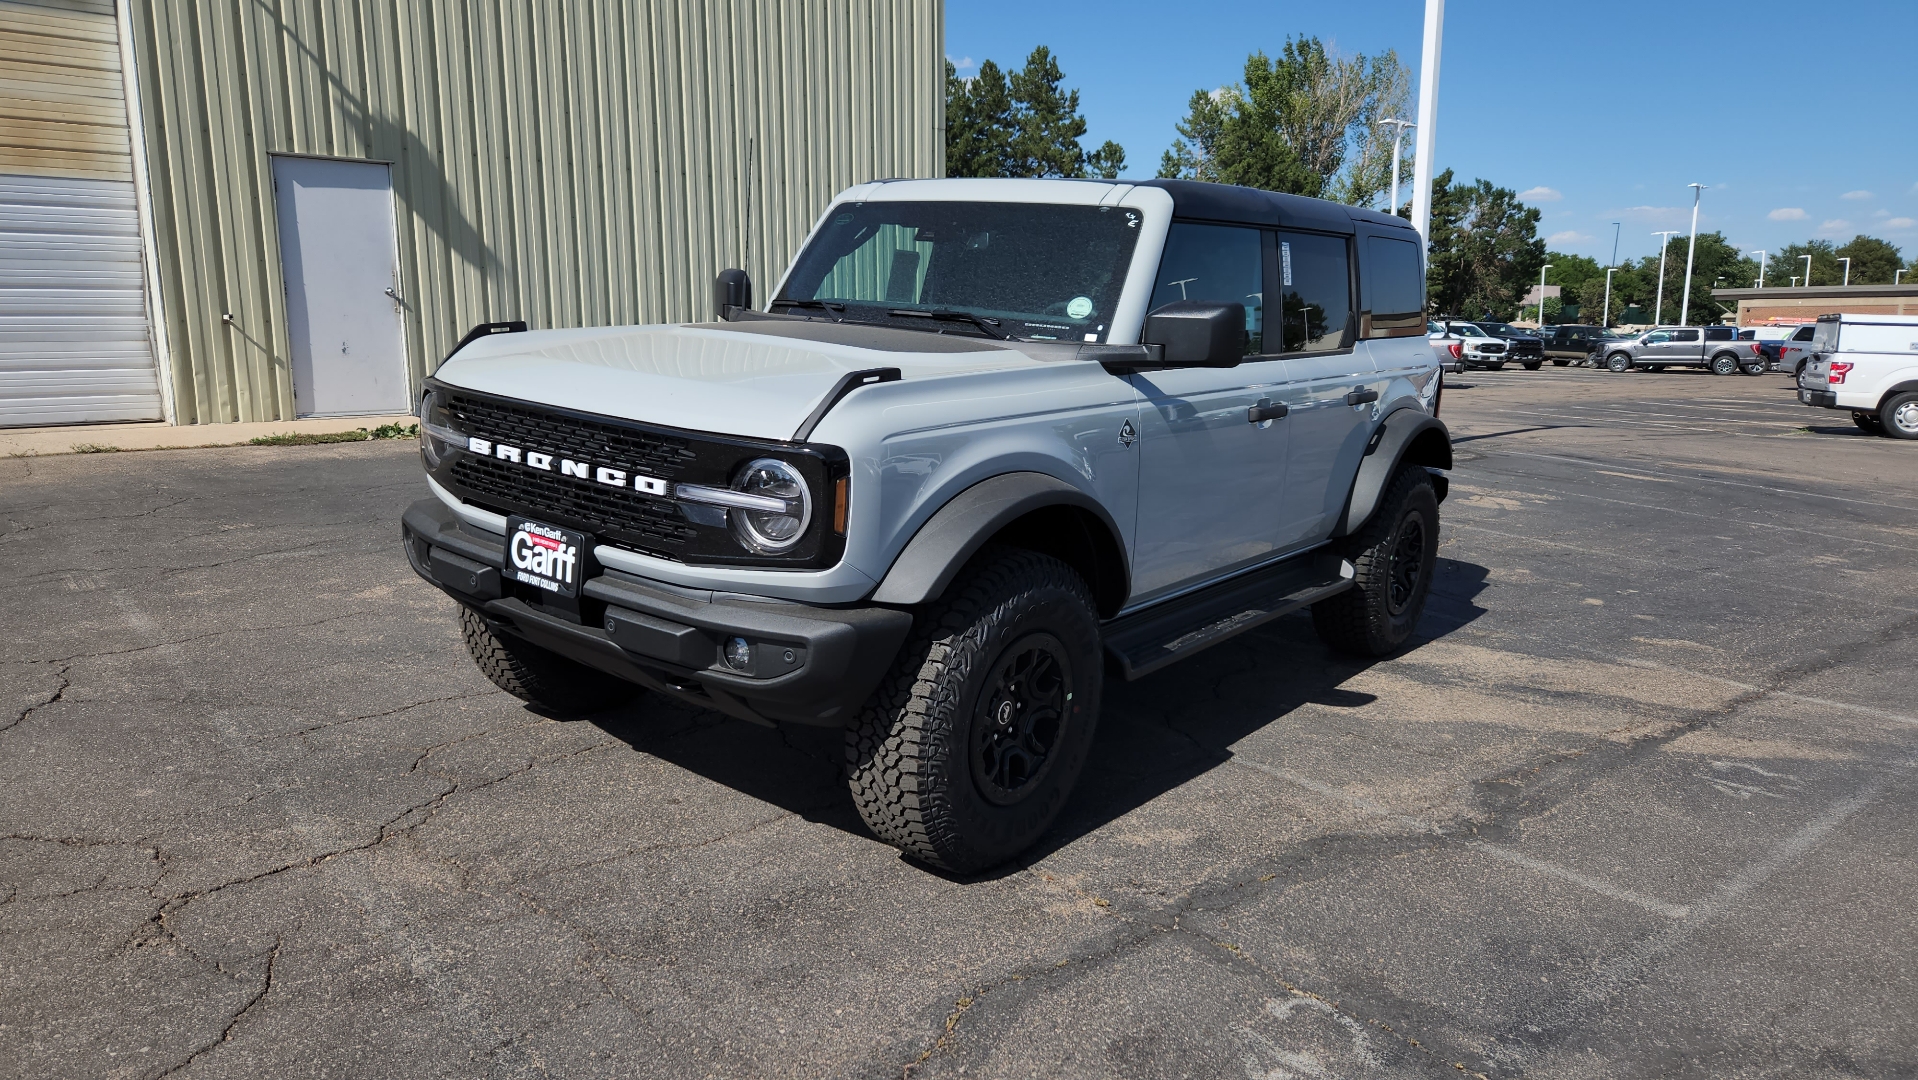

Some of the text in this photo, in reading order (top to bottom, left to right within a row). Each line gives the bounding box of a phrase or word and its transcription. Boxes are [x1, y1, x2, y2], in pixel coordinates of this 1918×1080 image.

[469, 437, 667, 496] BRONCO
[511, 530, 576, 584] Garff
[517, 571, 530, 583] FORD
[528, 575, 541, 586] FORT
